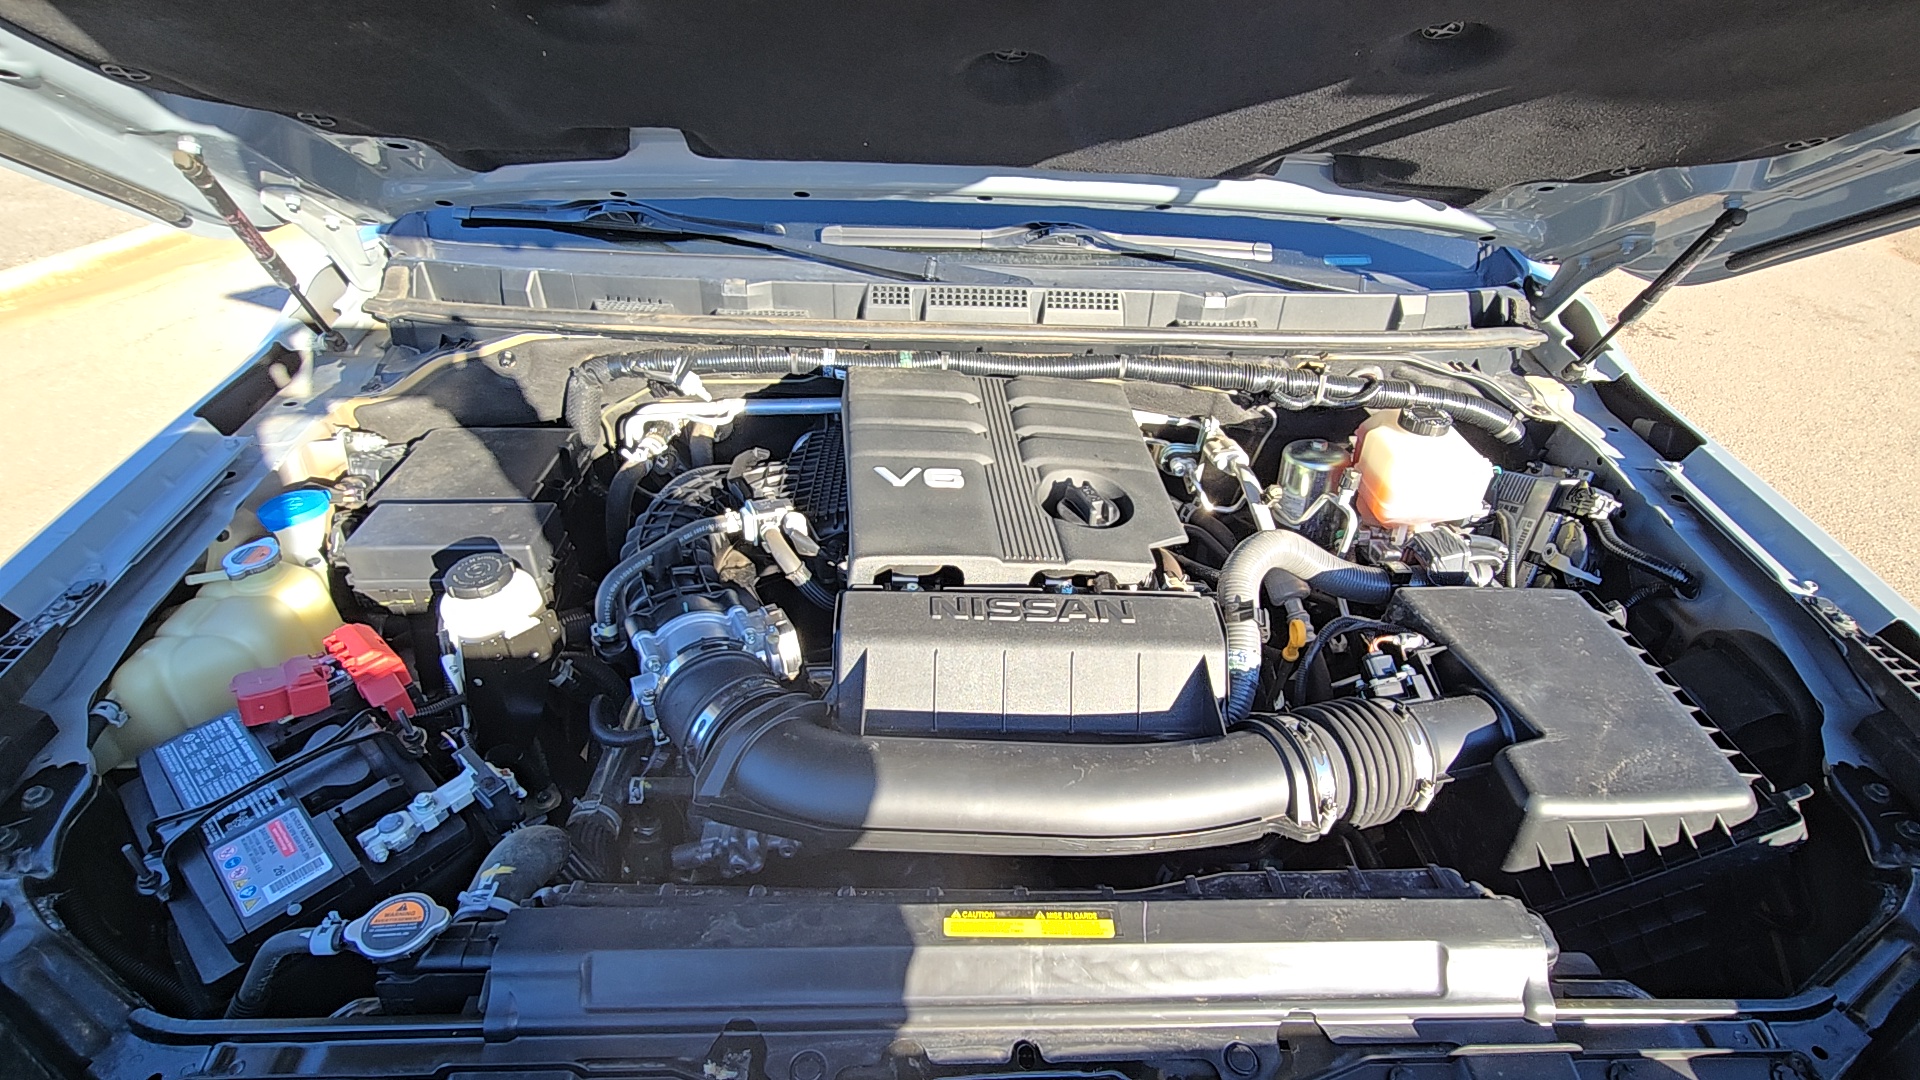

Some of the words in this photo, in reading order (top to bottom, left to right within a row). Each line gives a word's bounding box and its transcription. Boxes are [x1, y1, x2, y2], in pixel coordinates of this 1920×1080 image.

[873, 466, 965, 489] V6
[929, 595, 1136, 624] NISSAN
[272, 865, 286, 877] 26
[961, 911, 996, 919] CAUTION
[1045, 911, 1063, 920] MISE
[1063, 911, 1074, 920] EN
[1073, 911, 1098, 920] GARDE
